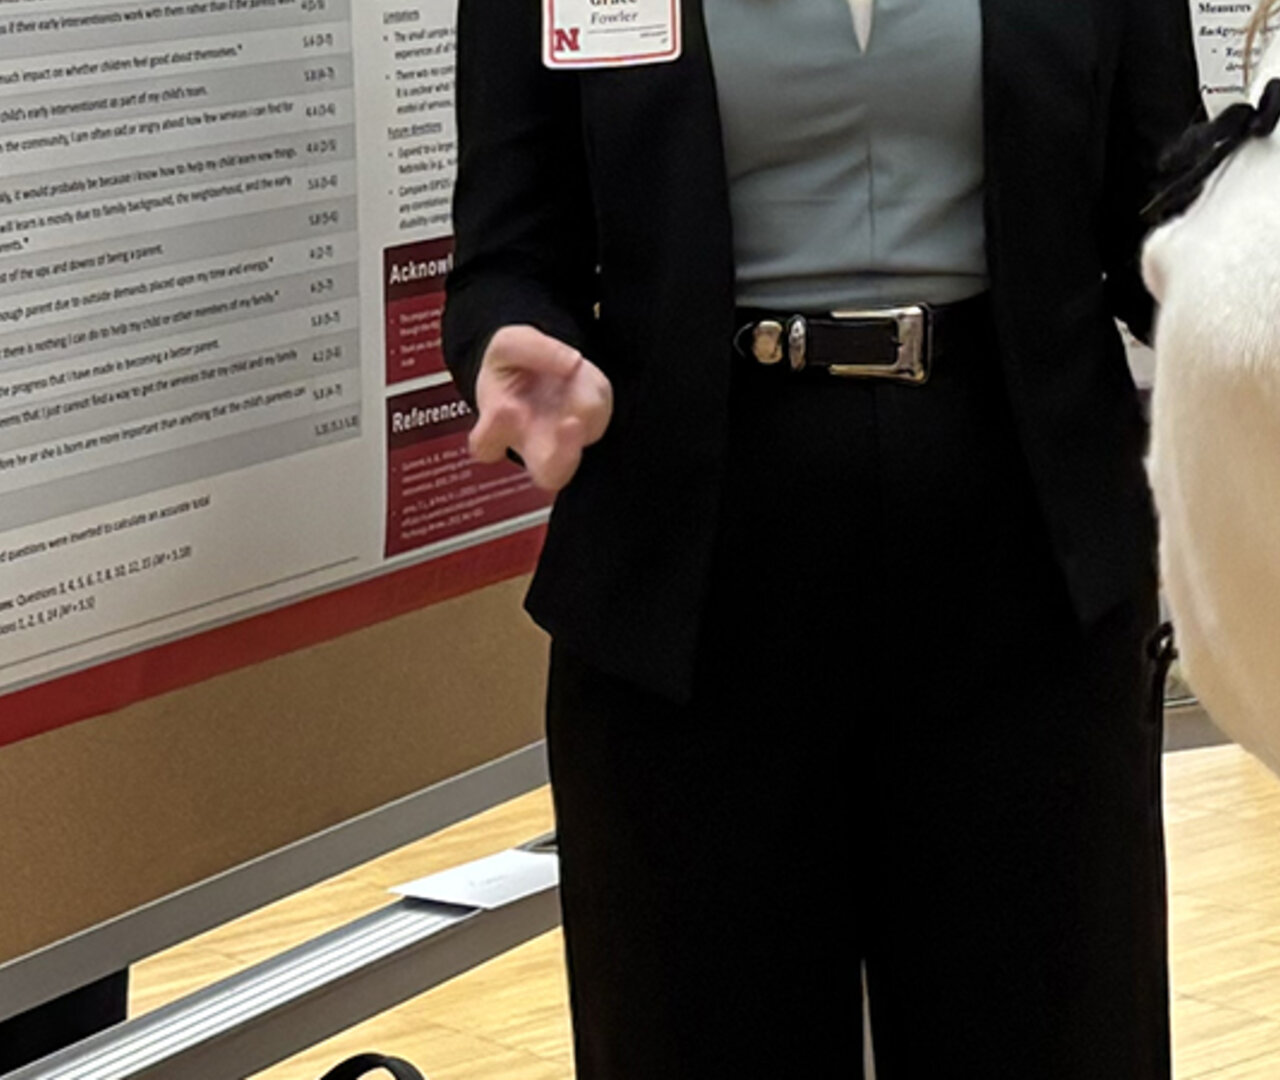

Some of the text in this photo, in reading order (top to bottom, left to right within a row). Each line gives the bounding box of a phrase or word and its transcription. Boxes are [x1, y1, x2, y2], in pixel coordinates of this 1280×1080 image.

[1198, 3, 1251, 13] Measures
[591, 11, 638, 24] Fowler
[555, 27, 580, 52] N
